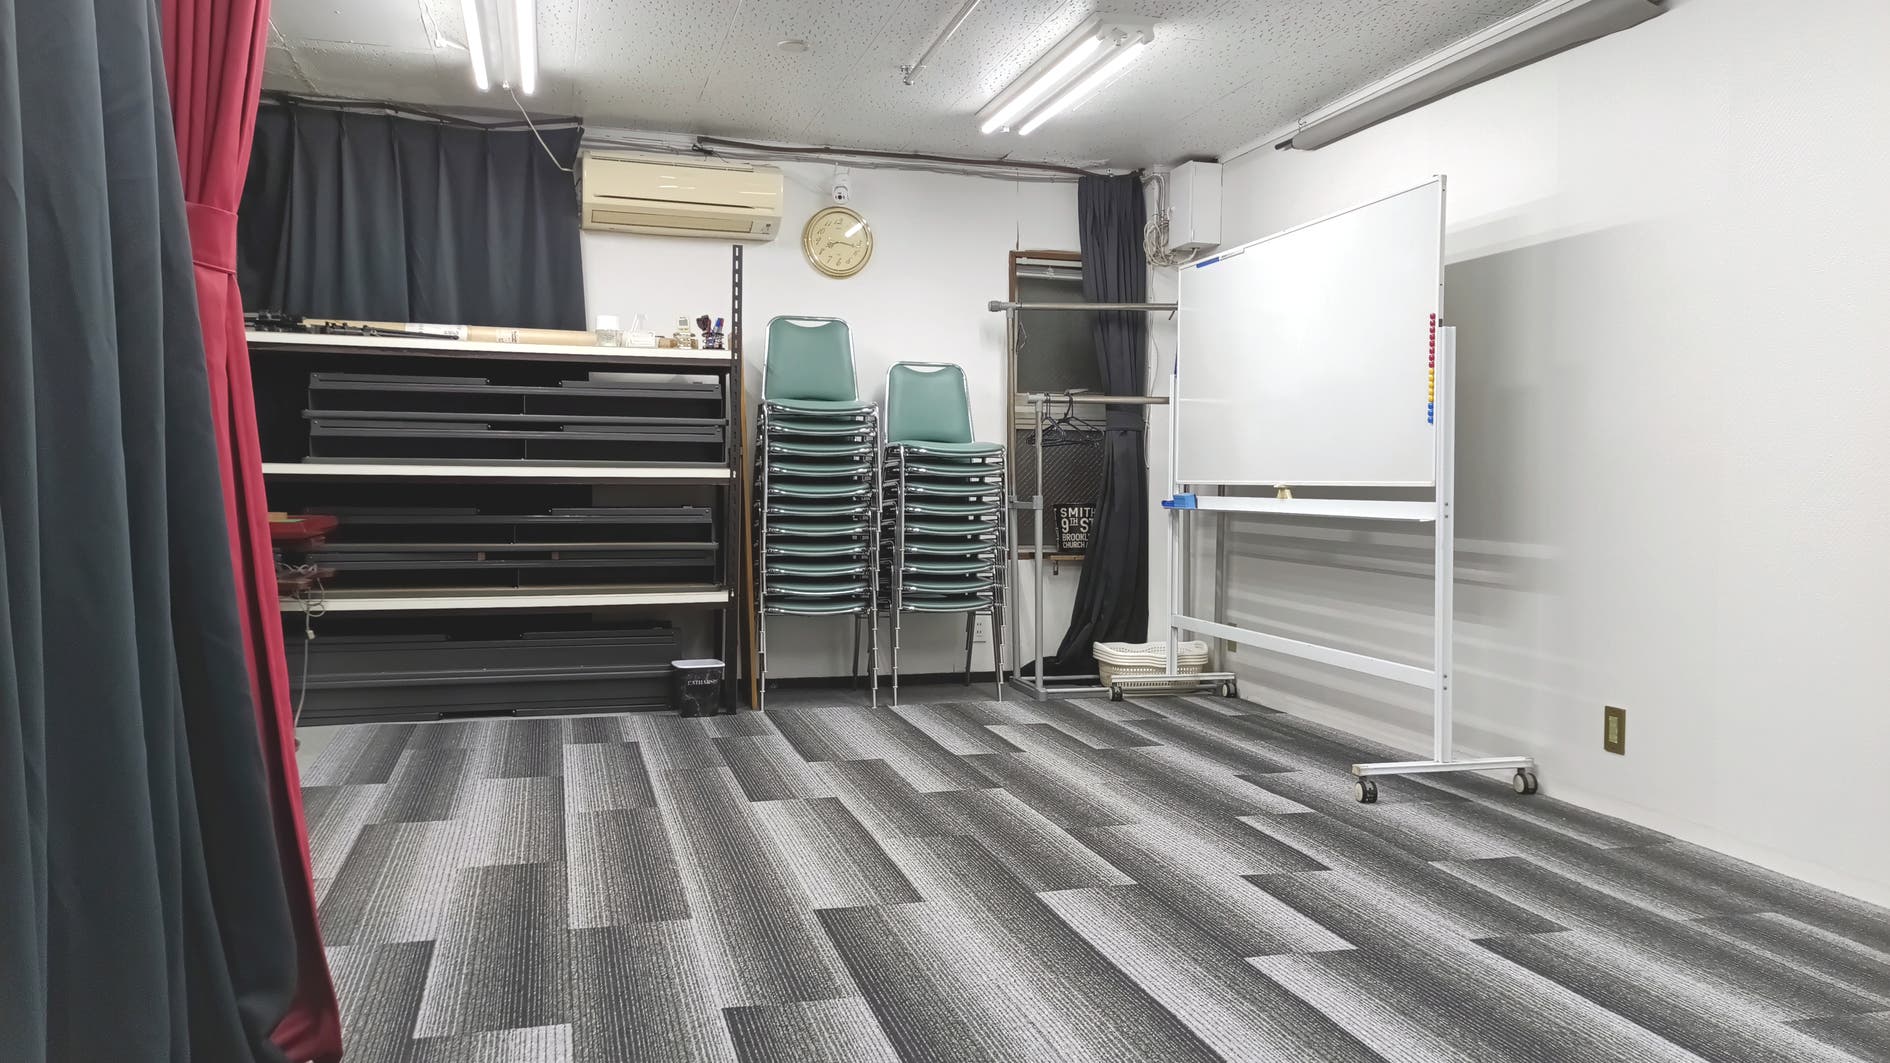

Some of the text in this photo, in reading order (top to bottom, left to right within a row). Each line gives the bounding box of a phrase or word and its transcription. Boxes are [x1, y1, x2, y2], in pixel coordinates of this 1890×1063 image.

[1060, 507, 1096, 518] SMITH
[1061, 517, 1079, 533] 9TH
[1062, 533, 1090, 541] BROOKL
[1062, 541, 1085, 549] CHURCH
